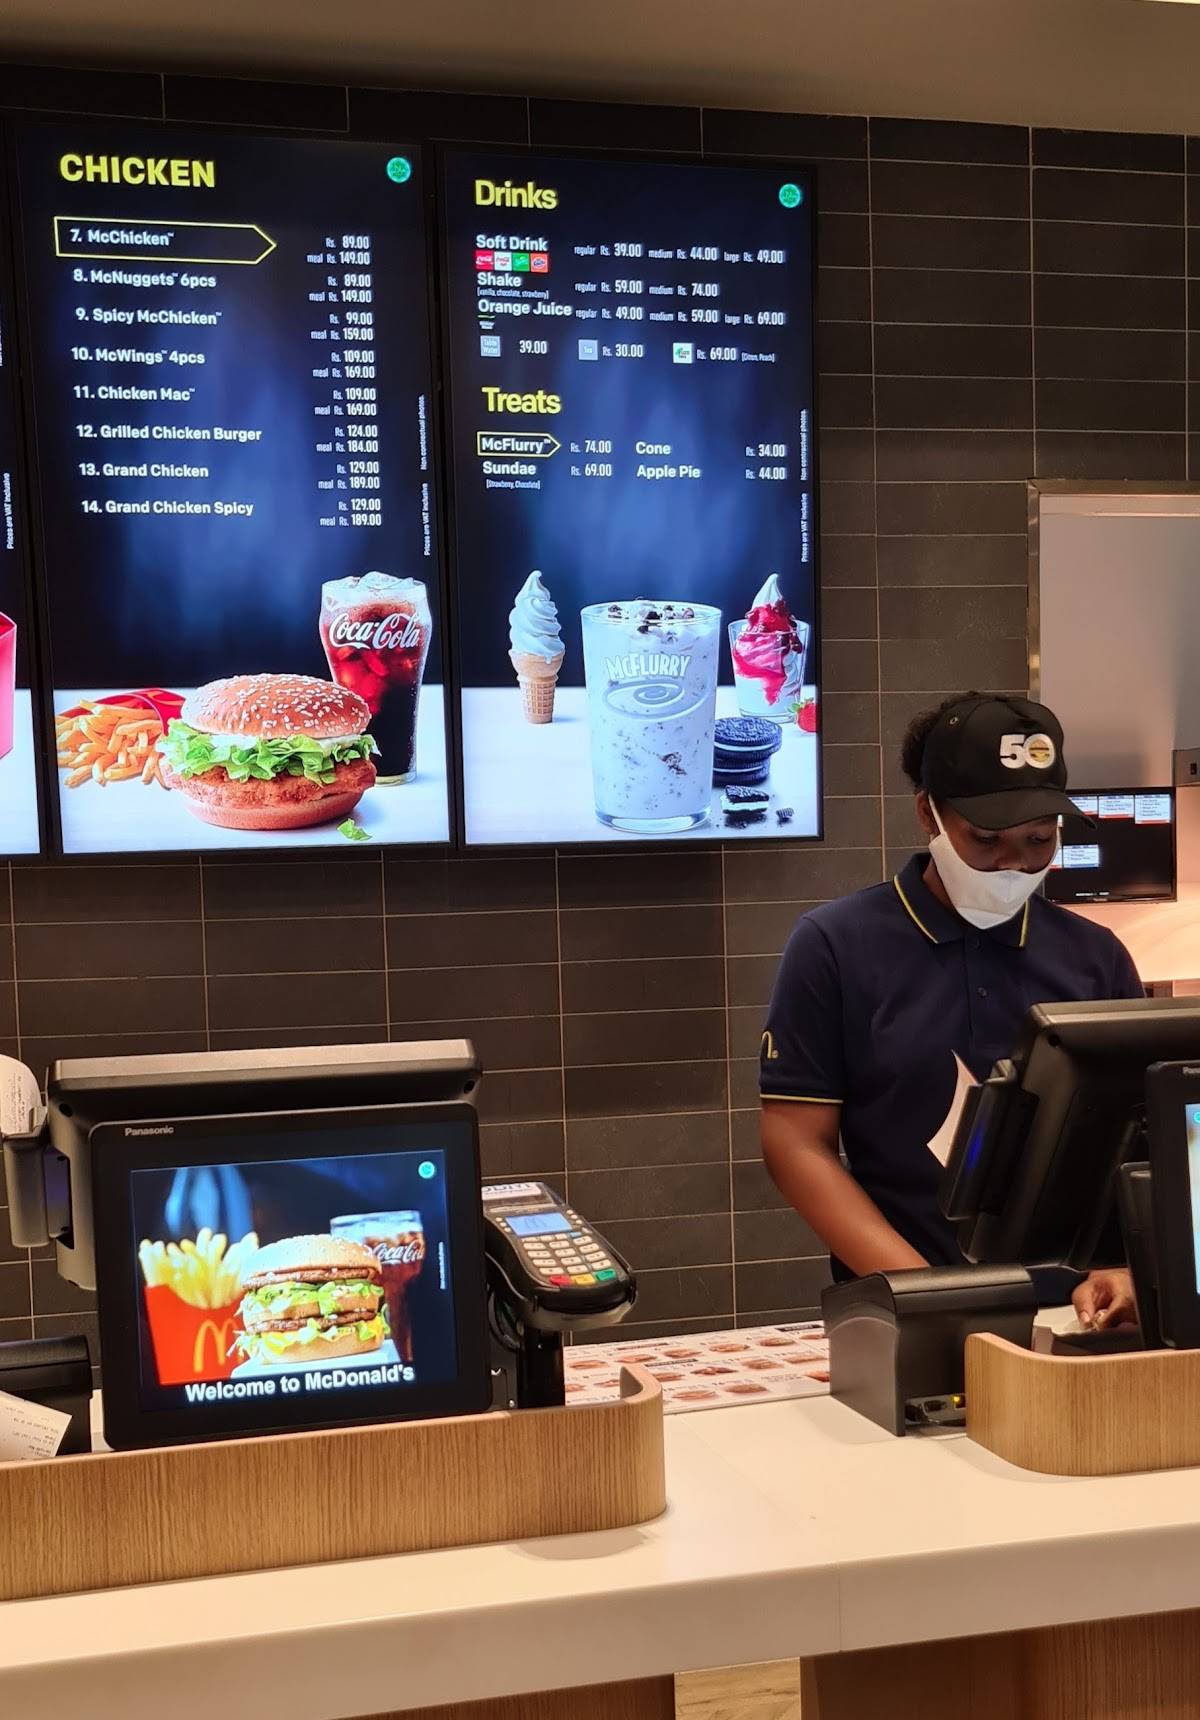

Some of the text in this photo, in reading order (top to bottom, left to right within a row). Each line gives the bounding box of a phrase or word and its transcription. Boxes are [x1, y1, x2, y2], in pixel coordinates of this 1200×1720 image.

[60, 154, 216, 187] CHICKEN
[475, 180, 558, 209] Drinks
[70, 229, 83, 242] 7.
[326, 235, 370, 250] Rs. 89.00
[476, 235, 549, 251] Soft Drink
[307, 251, 371, 265] meal Rs. 149.00
[574, 243, 784, 264] regular Rs. 39.00 medium Rs. 44.00 large Rs. 49.00
[73, 269, 88, 282] 8.
[180, 275, 216, 288] 6pcs
[327, 274, 371, 288] Rs. 89.00
[477, 272, 522, 287] Shake
[575, 280, 718, 297] regular Rs. 59.00 medium Rs. 74.00
[309, 289, 372, 303] meal Rs. 149.00
[478, 299, 572, 316] Orange Juice
[76, 307, 90, 321] 9.
[92, 308, 134, 325] Spicy
[329, 312, 373, 326] Rs. 99.00
[575, 307, 784, 326] regular Rs. 49.00 medium Rs. 59.00 large Rs. 69.00
[311, 327, 374, 341] meal Rs. 159.00
[519, 340, 547, 354] 39.00
[603, 344, 643, 358] Rs. 30.00
[71, 347, 93, 361] 10.
[169, 351, 205, 365] 4pcs
[331, 350, 374, 364] Rs. 109.00
[697, 350, 706, 360] Rs.
[710, 348, 736, 361] 69.00
[312, 365, 375, 379] meal Rs. 169.00
[73, 386, 95, 399] 11.
[98, 386, 157, 400] Chicken
[333, 388, 377, 401] Rs. 109.00
[482, 387, 561, 414] Treats
[314, 403, 377, 417] meal Rs. 169.00
[76, 425, 262, 443] 12. Grilled Chicken Burger
[335, 425, 378, 439] Rs. 124.00
[316, 441, 379, 454] meal Rs. 184.00
[570, 440, 612, 454] Rs. 74.00
[636, 442, 671, 455] Cone
[746, 444, 785, 458] Rs. 34.00
[79, 463, 209, 478] 13. Grand Chicken
[336, 462, 380, 475] Rs. 129.00
[420, 457, 428, 470] Non
[483, 461, 536, 475] Sundae
[571, 463, 612, 477] Rs. 69.00
[637, 466, 701, 479] Apple Pie
[746, 467, 785, 480] Rs. 44.00
[318, 477, 381, 491] meal Rs. 189.00
[4, 503, 12, 516] VAT
[81, 501, 254, 517] 14. Grand Chicken Spicy
[338, 499, 381, 512] Rs. 129.00
[320, 514, 382, 528] meal Rs. 189.00
[329, 612, 420, 650] Coca-Cola
[1000, 733, 1055, 769] 50
[125, 1126, 174, 1137] Panasonic
[185, 1363, 416, 1403] Welcome to McDonald's
